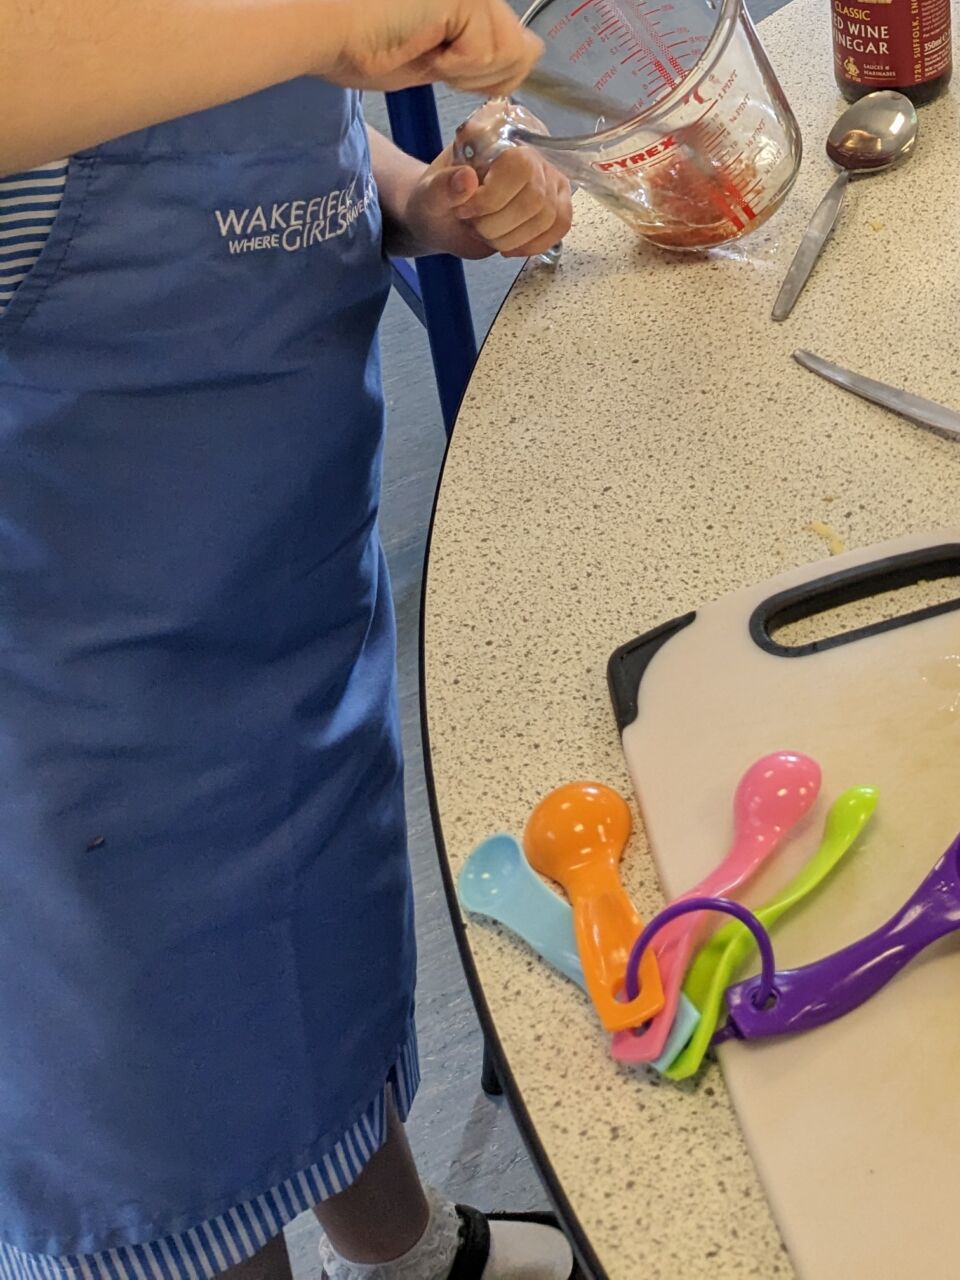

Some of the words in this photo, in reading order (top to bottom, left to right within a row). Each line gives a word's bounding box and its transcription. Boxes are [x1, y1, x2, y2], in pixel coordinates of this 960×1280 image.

[833, 13, 843, 30] ED
[848, 21, 889, 39] WINE
[835, 1, 871, 21] CLASSIC
[912, 16, 921, 59] SUFFOLK,
[599, 135, 677, 172] PYREX
[229, 234, 279, 254] WHERE
[282, 209, 347, 252] GIRLS
